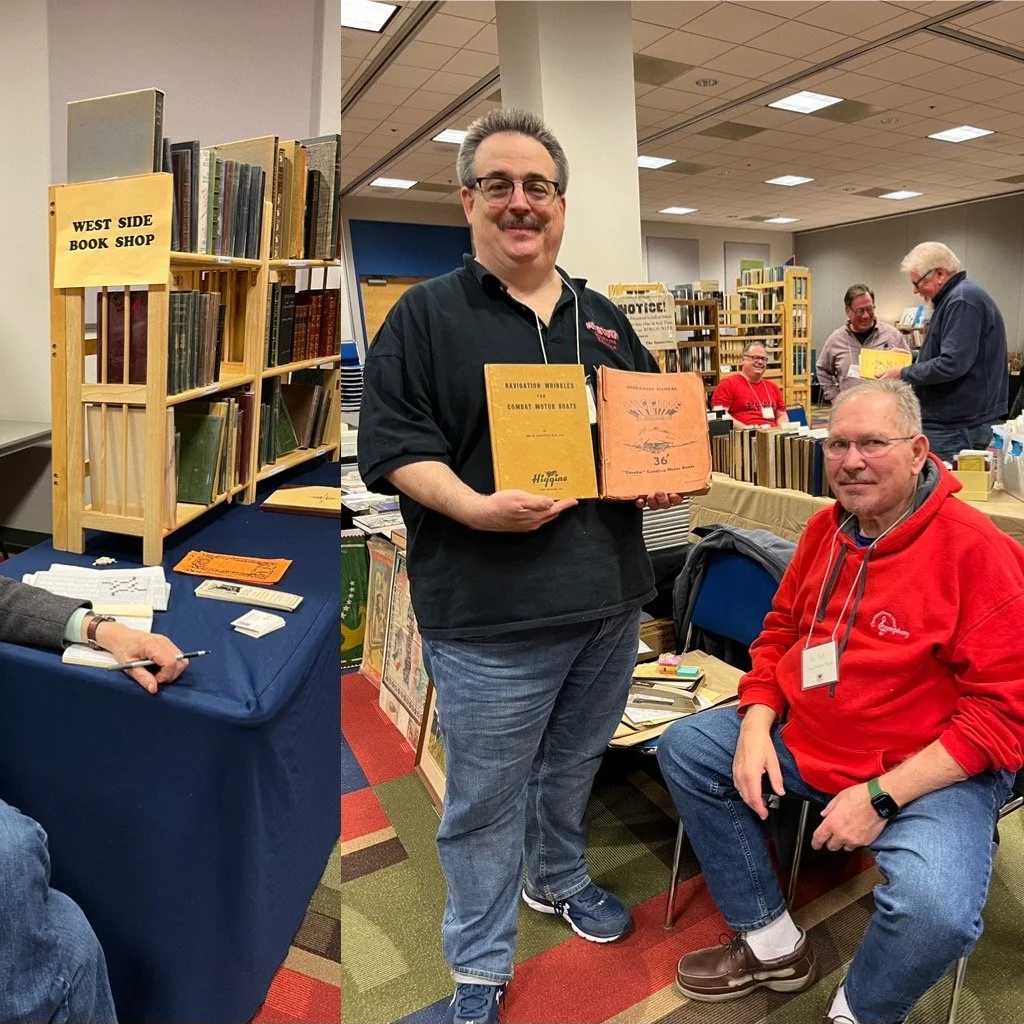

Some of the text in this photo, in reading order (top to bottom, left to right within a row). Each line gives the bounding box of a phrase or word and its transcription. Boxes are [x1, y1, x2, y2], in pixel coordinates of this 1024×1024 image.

[73, 215, 153, 232] WEST SIDE
[70, 234, 155, 251] BOOK SHOP
[618, 302, 666, 314] NOTICE!
[532, 473, 568, 487] Higgins
